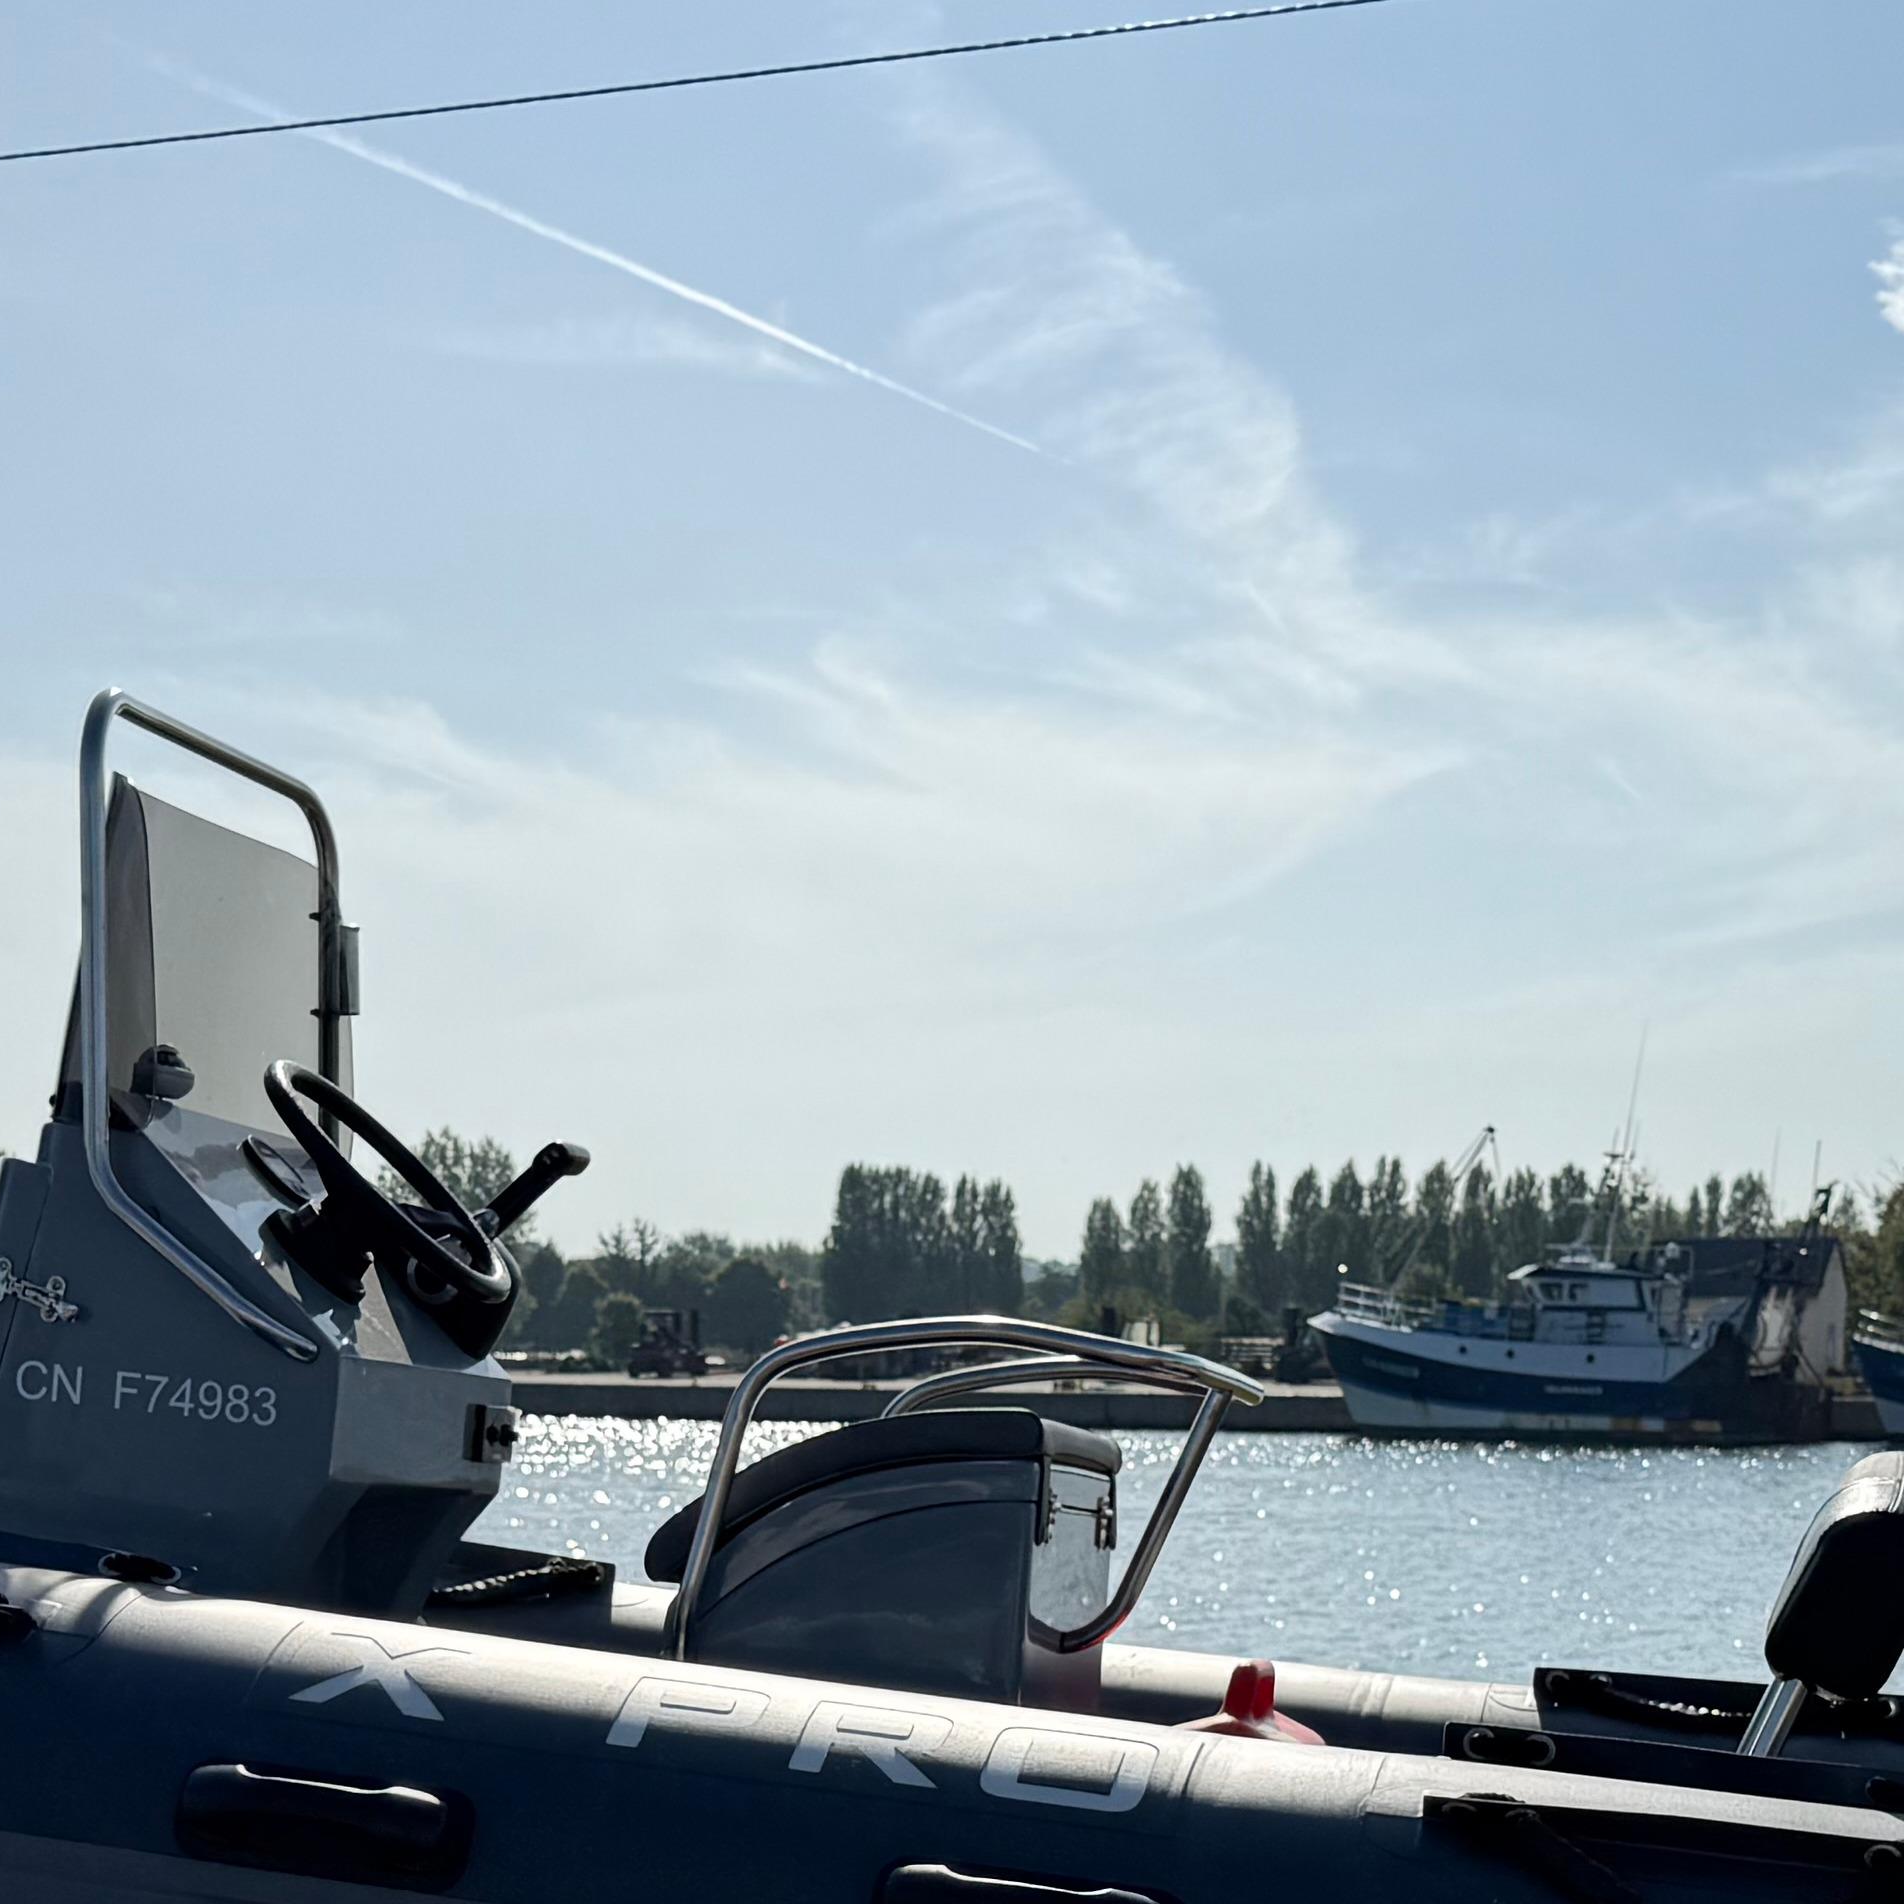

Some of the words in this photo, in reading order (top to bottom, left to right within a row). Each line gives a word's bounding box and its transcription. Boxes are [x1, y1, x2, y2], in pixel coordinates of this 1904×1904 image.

[15, 1359, 84, 1405] CN
[112, 1370, 278, 1427] F74983
[288, 1630, 473, 1722] X
[604, 1674, 1161, 1814] PRO
